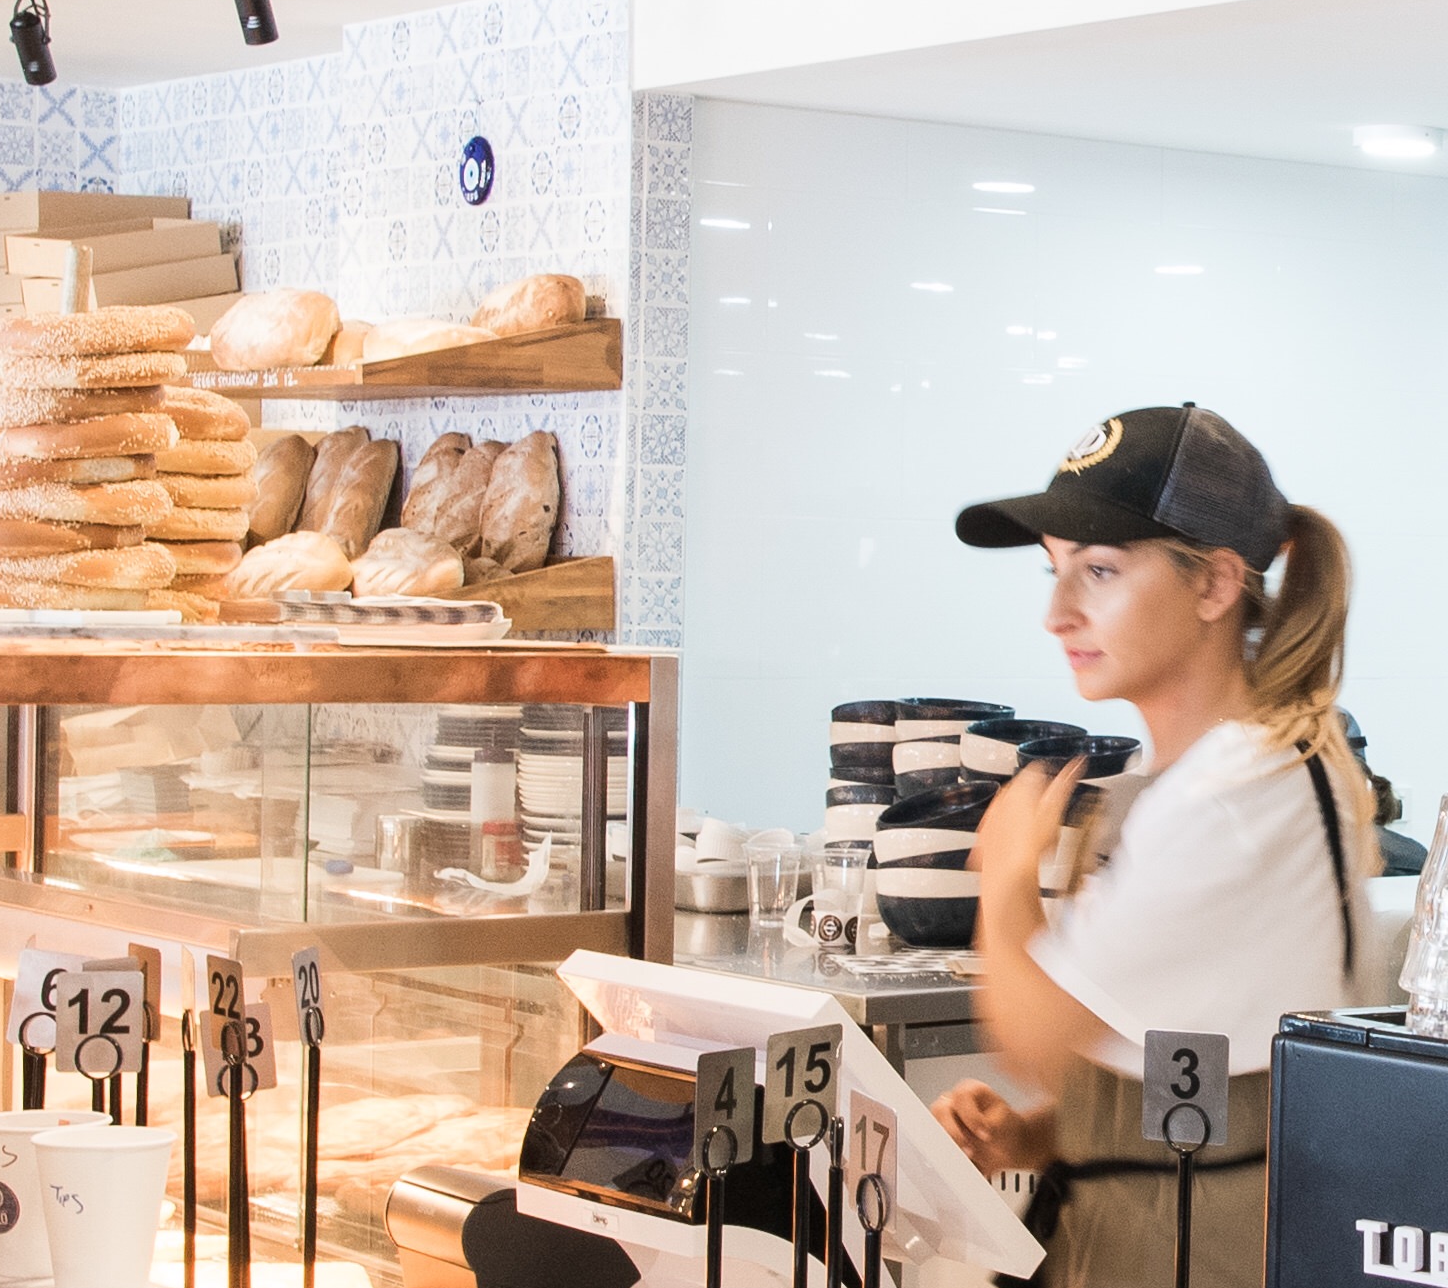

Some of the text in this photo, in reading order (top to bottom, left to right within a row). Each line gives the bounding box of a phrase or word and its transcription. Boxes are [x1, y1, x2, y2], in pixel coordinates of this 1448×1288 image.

[210, 971, 242, 1019] 22
[298, 961, 320, 1009] 20
[67, 988, 132, 1036] 12
[714, 1065, 738, 1121] 4
[775, 1041, 832, 1098] 15
[1170, 1047, 1202, 1100] 3
[853, 1113, 892, 1175] 17
